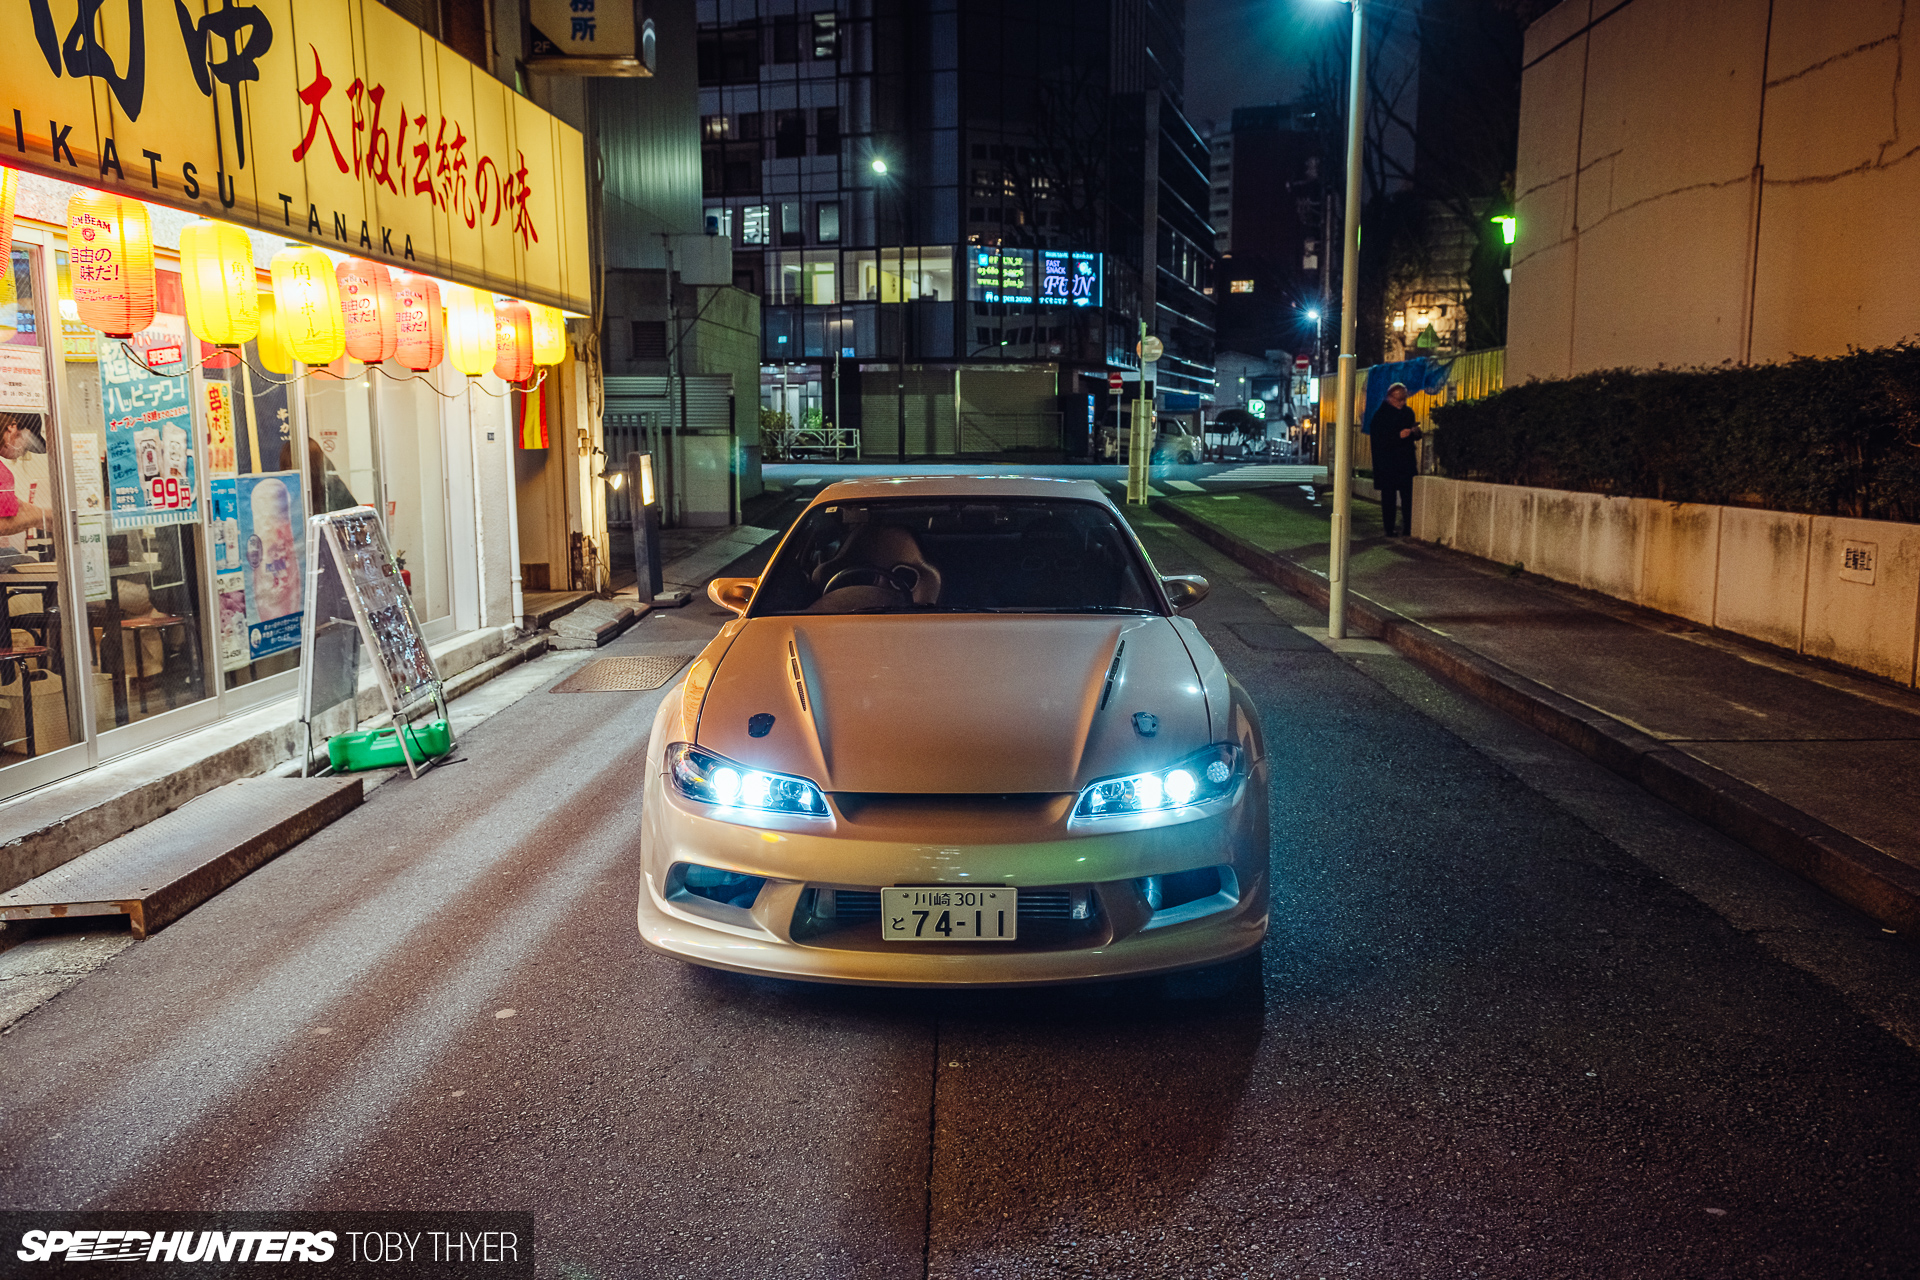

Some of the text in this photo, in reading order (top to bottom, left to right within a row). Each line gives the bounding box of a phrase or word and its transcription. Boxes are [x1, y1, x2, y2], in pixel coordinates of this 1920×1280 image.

[533, 40, 551, 53] 2F
[292, 43, 538, 251] 大阪伝統の味
[13, 108, 416, 262] IKATSU TANAKA
[84, 213, 111, 234] BEAM
[71, 246, 112, 264] 自由の
[80, 264, 119, 282] 味だ!
[1045, 267, 1067, 275] SNACK
[108, 376, 186, 415] ハッピーアワー!
[914, 893, 984, 906] 川崎 301
[892, 910, 1005, 937] と 74-11
